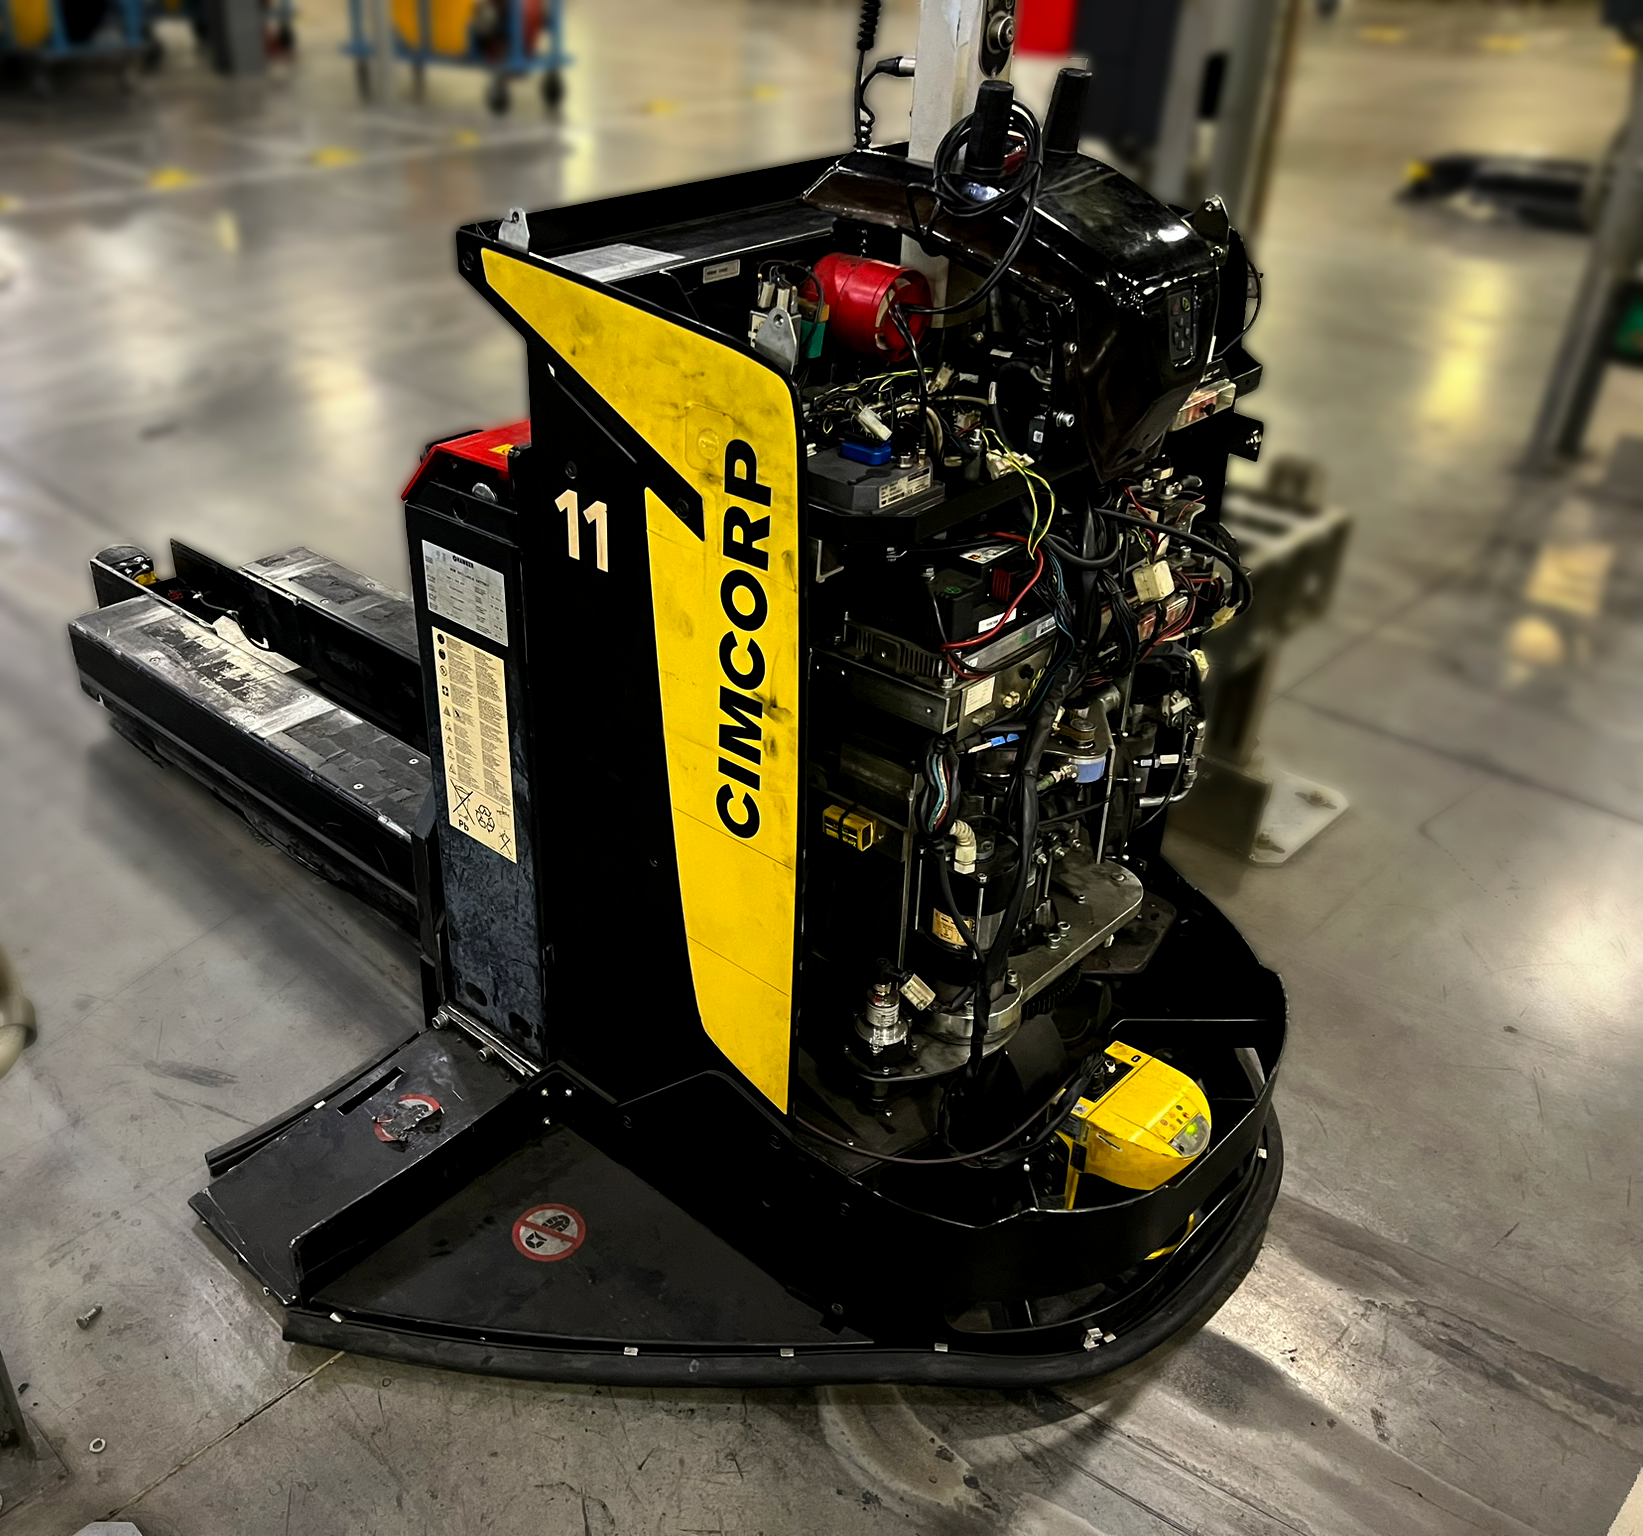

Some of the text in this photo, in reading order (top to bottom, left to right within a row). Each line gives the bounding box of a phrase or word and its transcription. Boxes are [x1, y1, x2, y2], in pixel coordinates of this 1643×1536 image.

[554, 489, 609, 572] 11
[716, 439, 772, 839] CIMCORP
[458, 819, 470, 831] Pb
